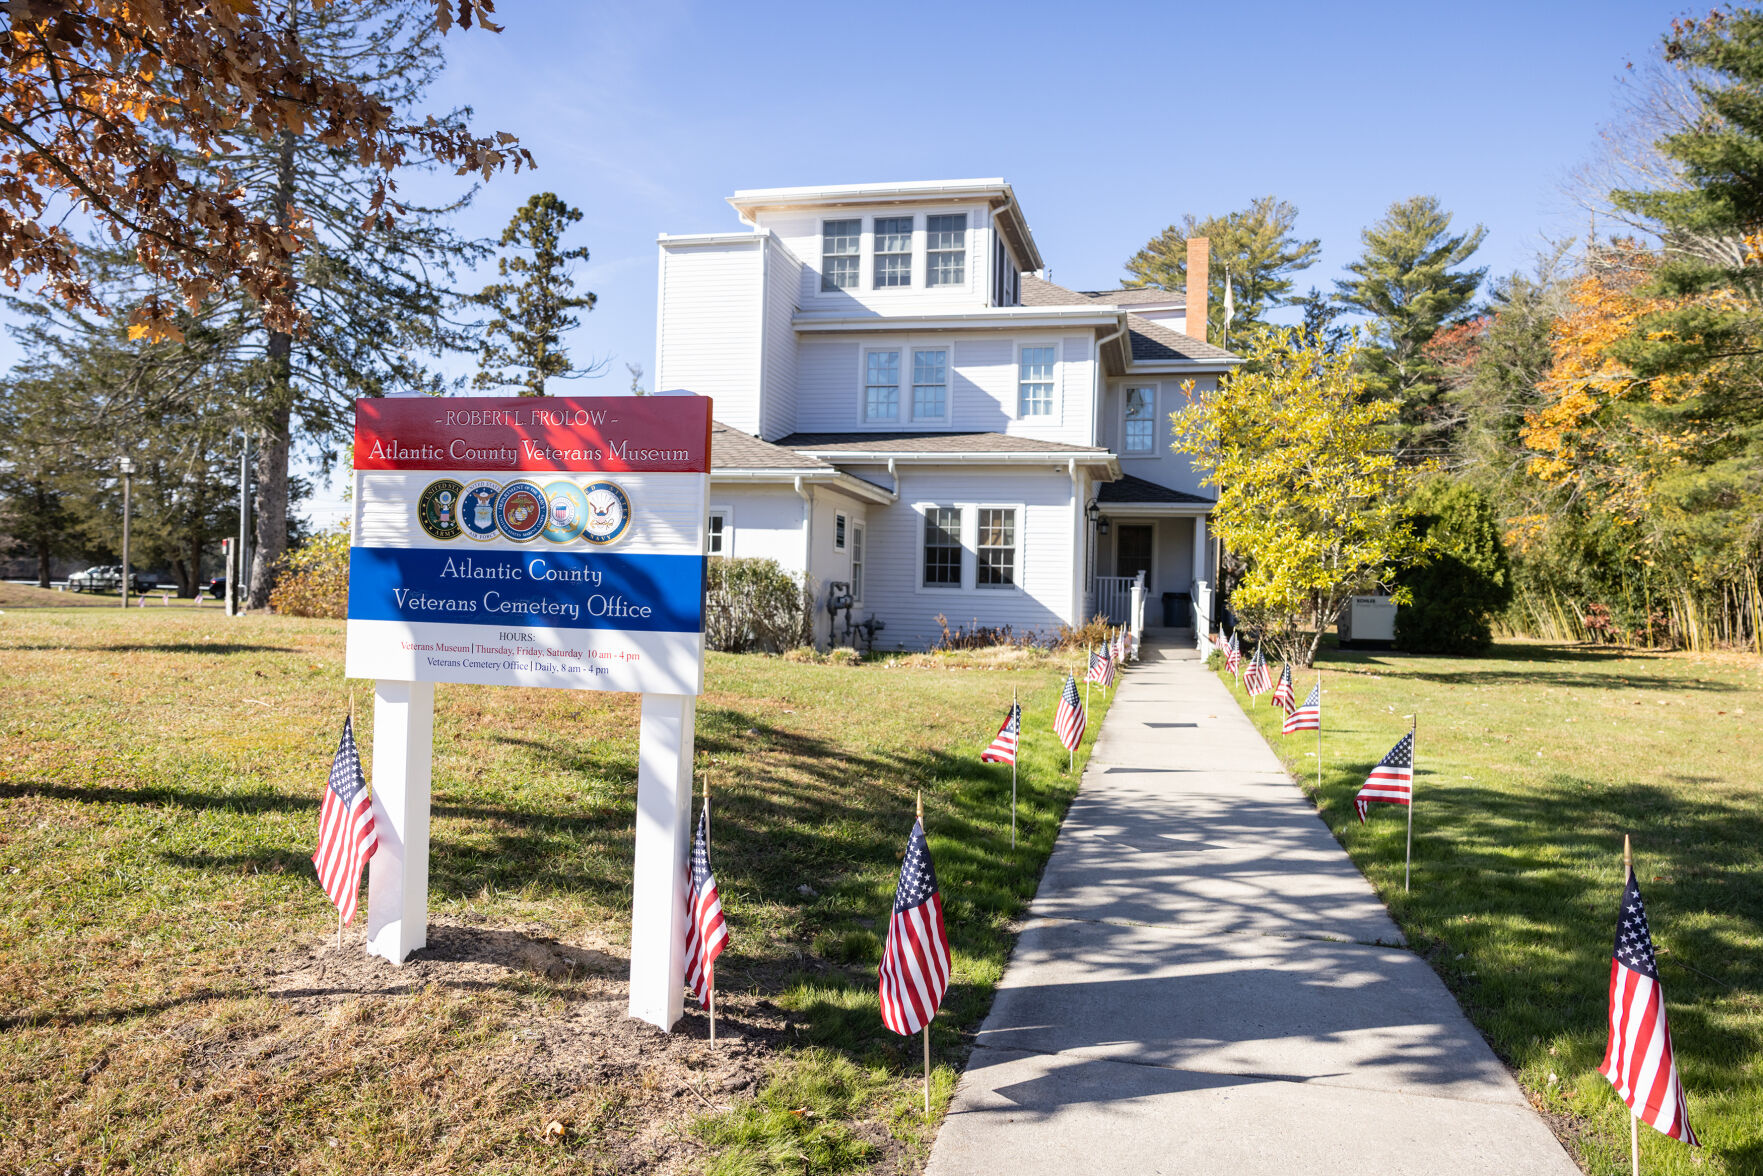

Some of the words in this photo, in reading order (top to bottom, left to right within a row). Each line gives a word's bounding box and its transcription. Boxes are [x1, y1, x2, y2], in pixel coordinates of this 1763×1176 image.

[445, 410, 511, 426] ROBERT
[531, 410, 607, 426] FROLOW
[368, 439, 444, 460] Atlantic
[450, 439, 517, 465] County
[521, 439, 602, 461] Veterans
[607, 440, 689, 461] Museum
[424, 482, 447, 500] UNITED
[466, 482, 485, 493] UNITED
[486, 481, 501, 491] STATE
[498, 485, 524, 510] DEPARTMENT
[537, 494, 546, 510] NAVY
[469, 531, 479, 539] AIR
[480, 531, 496, 540] FORCE
[440, 556, 522, 580] Atlantic
[528, 558, 602, 587] County
[392, 588, 477, 611] Veterans
[483, 591, 579, 620] Cemetery
[587, 594, 652, 617] Office
[499, 631, 536, 641] HOURS:
[401, 641, 434, 651] Veterans
[436, 643, 470, 653] Museum
[475, 644, 514, 656] Thursday,
[516, 646, 544, 658] Friday,
[547, 647, 583, 659] Saturday
[587, 649, 597, 658] 10
[599, 651, 612, 659] am
[618, 651, 625, 659] 4
[626, 652, 640, 662] pm
[427, 657, 461, 667] Veterans
[462, 659, 501, 671] Cemetery
[503, 660, 529, 670] Office
[535, 662, 559, 673] Daily,
[561, 663, 566, 671] 8
[568, 665, 581, 673] am
[588, 664, 594, 673] 4
[595, 666, 609, 676] pm
